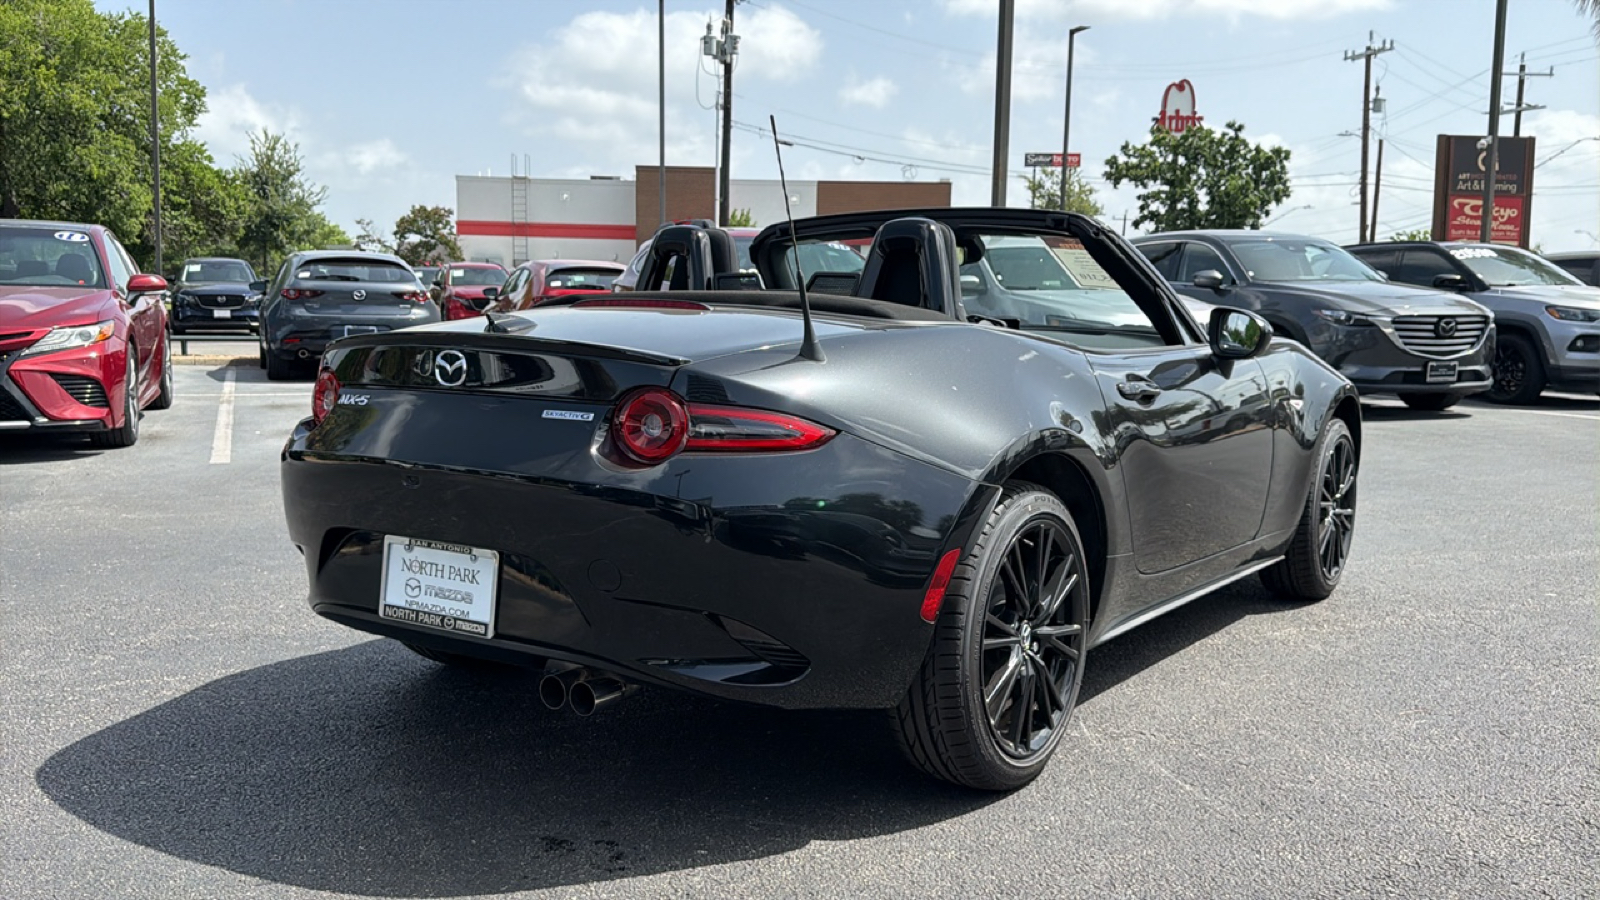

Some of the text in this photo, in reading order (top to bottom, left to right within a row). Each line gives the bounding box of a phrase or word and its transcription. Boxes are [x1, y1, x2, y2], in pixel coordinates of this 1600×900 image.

[1457, 180, 1471, 191] Art
[1453, 198, 1519, 222] Tkyo
[337, 393, 371, 406] MX-5
[431, 542, 471, 553] ANTONIO
[401, 556, 481, 585] NORTH PARK
[385, 605, 416, 621] NORTH
[418, 614, 442, 627] PARK
[404, 600, 470, 619] NPMAZDA.COM
